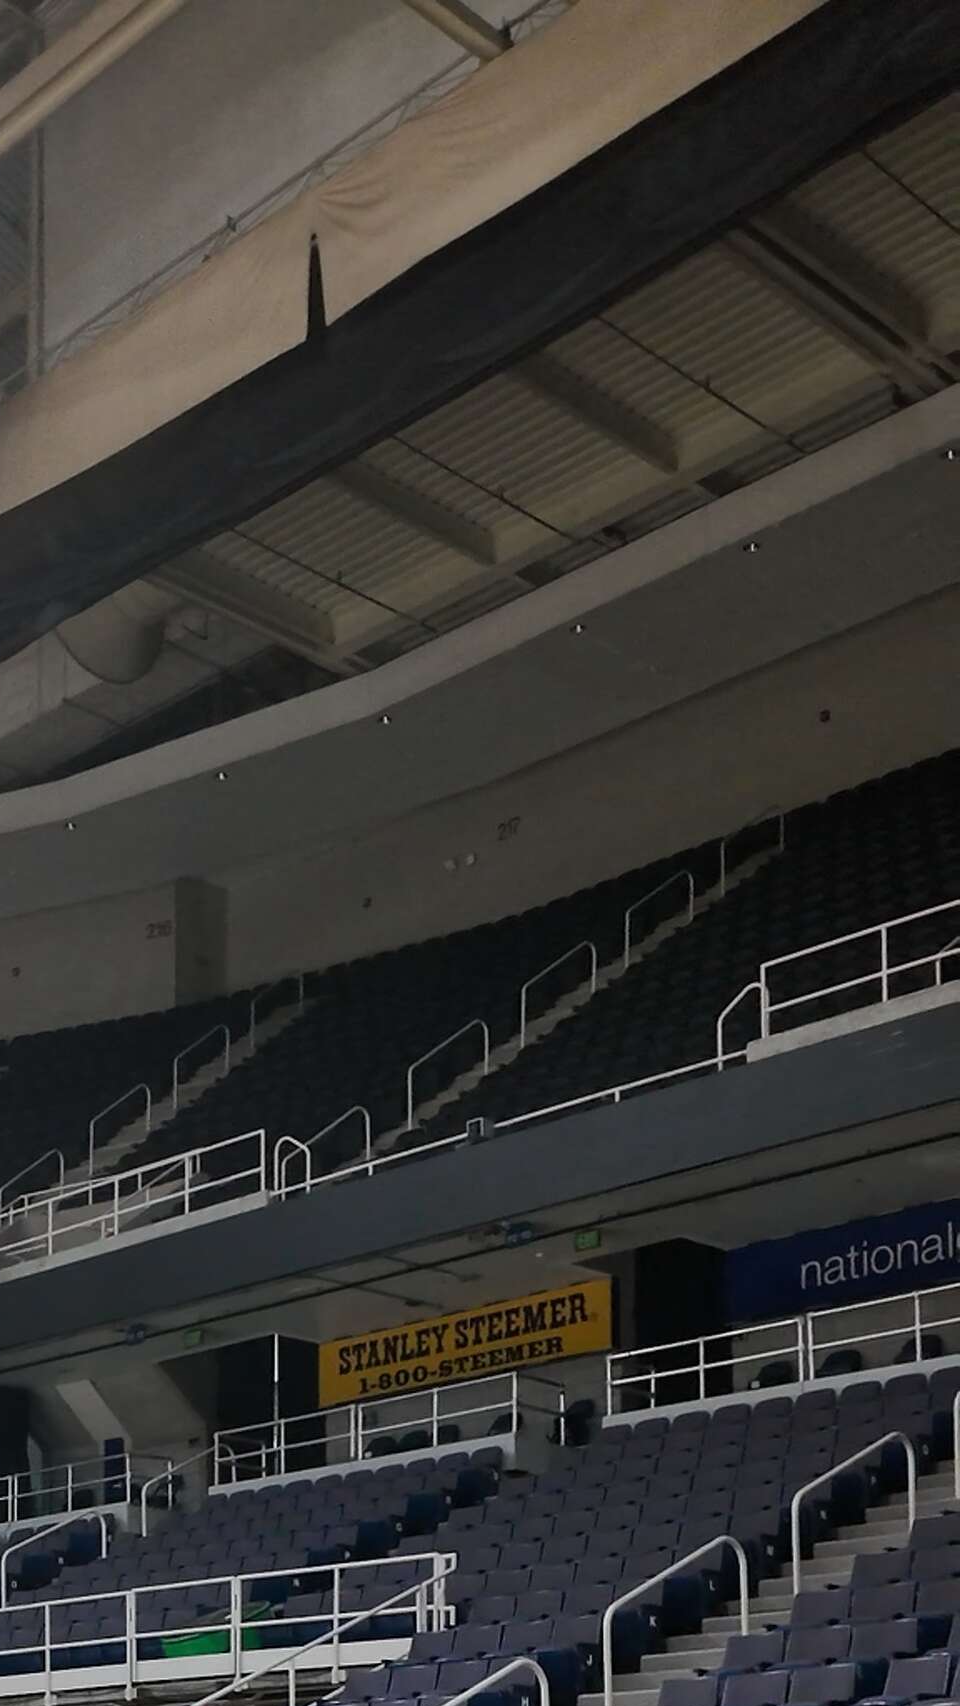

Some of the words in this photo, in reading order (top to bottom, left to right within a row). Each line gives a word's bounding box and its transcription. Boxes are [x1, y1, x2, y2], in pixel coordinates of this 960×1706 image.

[800, 1221, 960, 1290] national
[339, 1324, 449, 1376] STANLEY
[454, 1292, 588, 1350] STEEMER
[358, 1335, 564, 1394] 1-800-STEEMER
